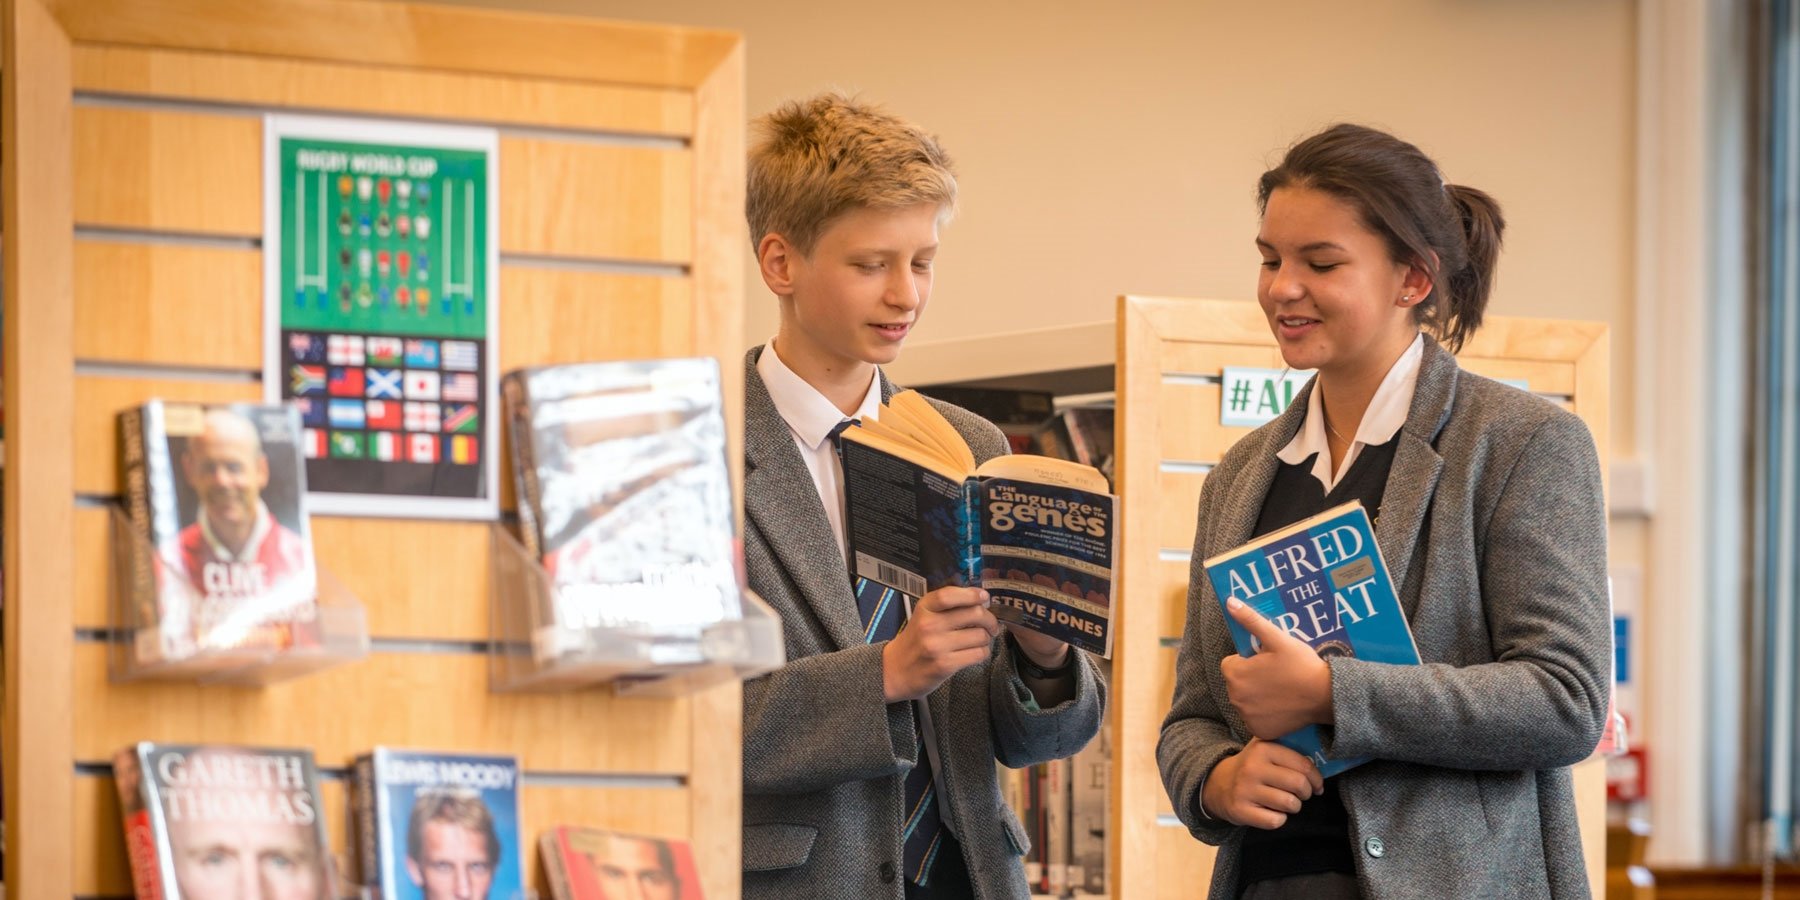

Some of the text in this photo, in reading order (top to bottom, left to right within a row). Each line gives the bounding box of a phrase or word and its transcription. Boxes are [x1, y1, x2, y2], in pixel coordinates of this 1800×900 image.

[296, 150, 348, 172] RUGBY
[350, 153, 406, 176] WORLD
[407, 156, 439, 178] CUP
[989, 488, 1093, 516] Language
[997, 485, 1017, 494] THE
[989, 501, 1106, 538] genes
[1228, 525, 1364, 600] ALFRED
[1287, 579, 1323, 604] THE
[990, 595, 1047, 618] STEVE
[1049, 608, 1103, 638] JONES
[1250, 577, 1379, 653] REAT
[158, 752, 305, 789] GARETH
[438, 761, 515, 791] MOODY
[160, 786, 316, 826] THOMAS
